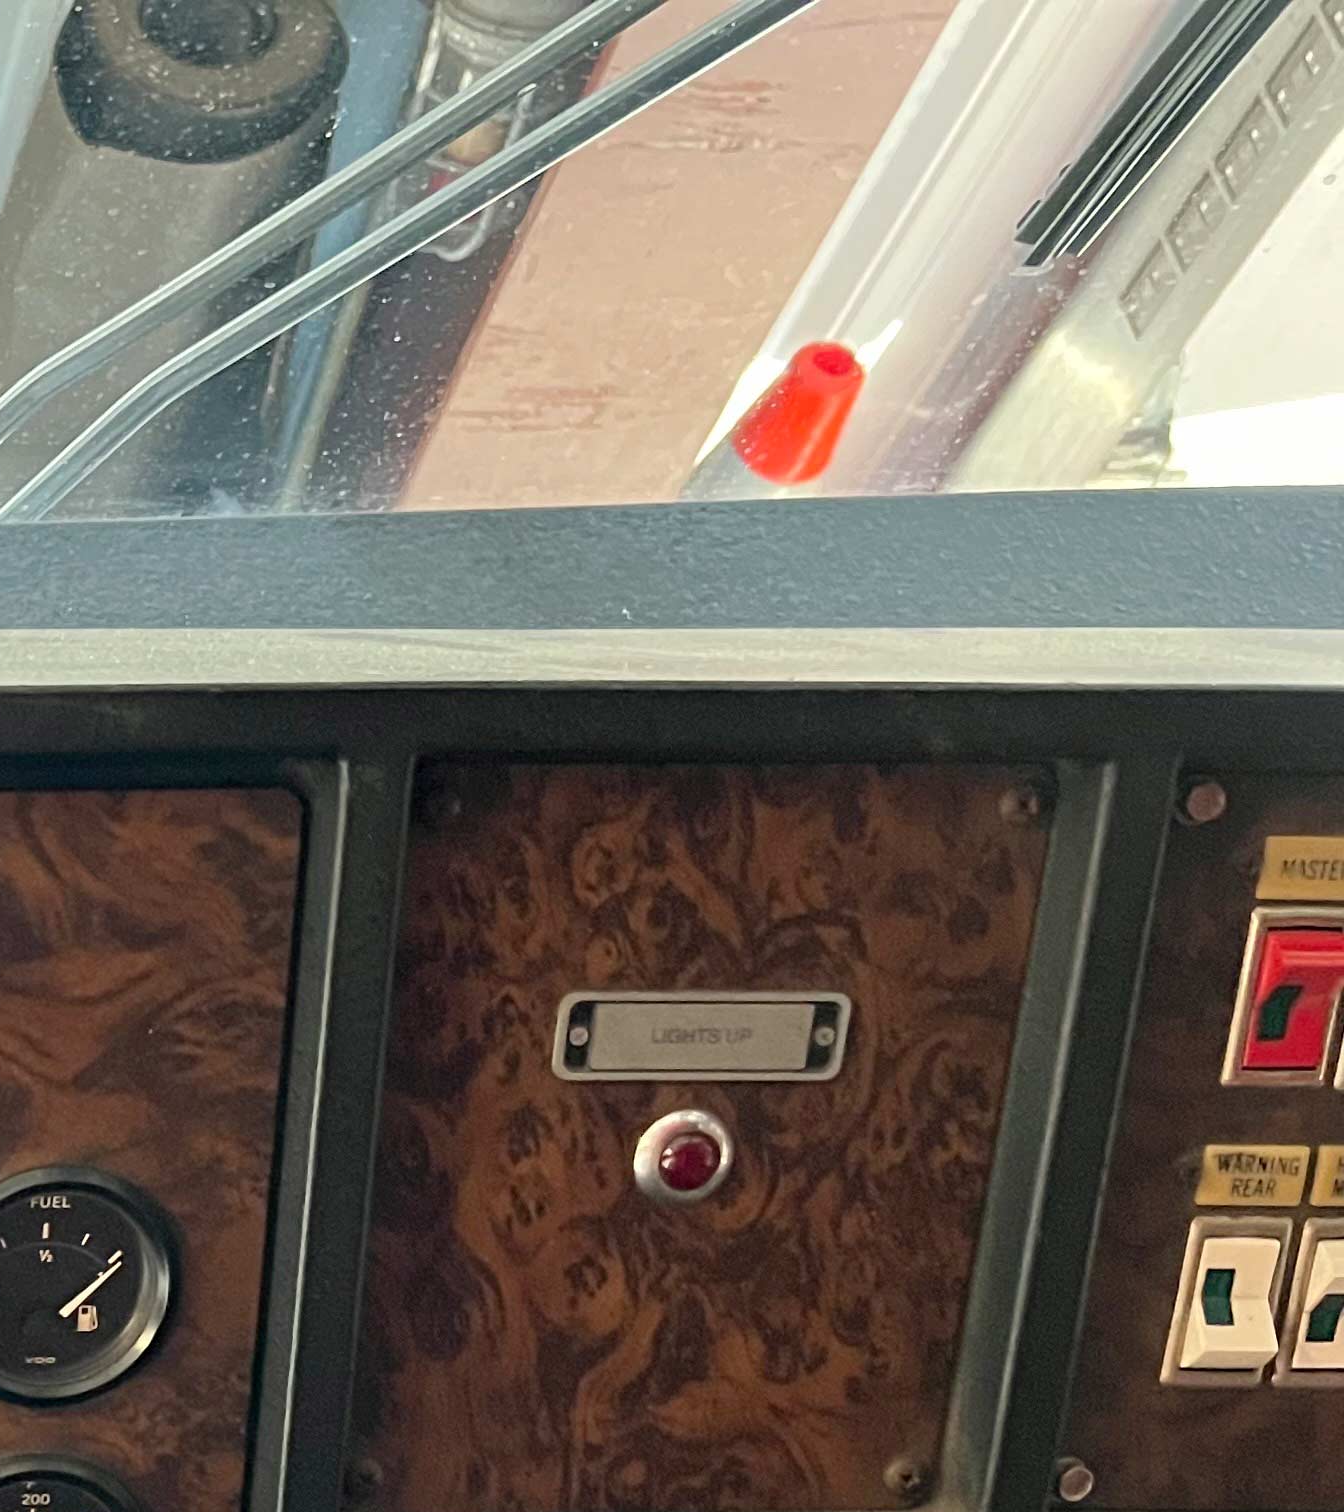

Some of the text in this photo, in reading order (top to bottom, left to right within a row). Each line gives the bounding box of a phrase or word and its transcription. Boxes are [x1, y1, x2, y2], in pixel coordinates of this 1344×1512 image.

[1281, 859, 1344, 881] MASTE
[650, 1027, 752, 1045] LIGHTS UP
[1217, 1153, 1300, 1176] WARNING
[1231, 1178, 1277, 1198] REAR
[30, 1195, 71, 1209] FUEL
[21, 1493, 50, 1506] 200
